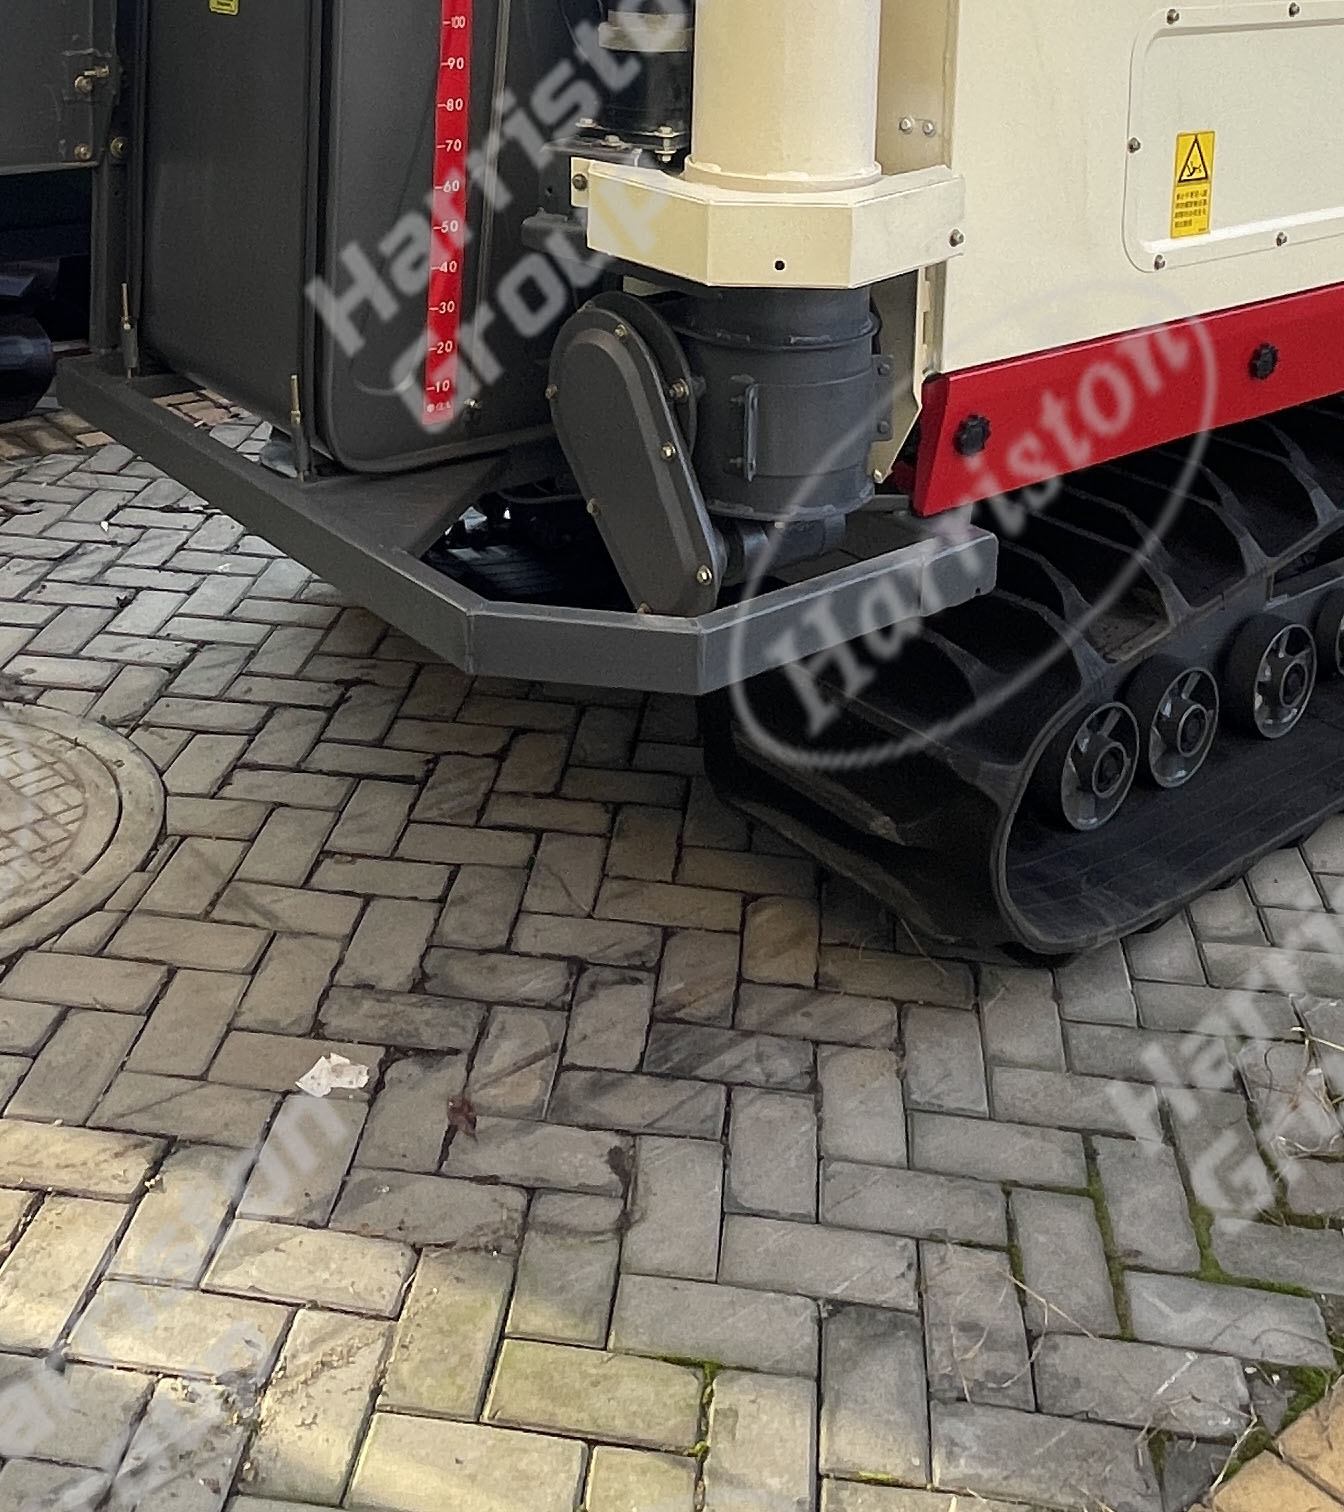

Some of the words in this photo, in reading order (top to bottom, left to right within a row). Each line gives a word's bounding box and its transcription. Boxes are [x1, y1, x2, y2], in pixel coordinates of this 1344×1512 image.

[447, 57, 464, 70] 90
[445, 98, 464, 112] 80
[444, 139, 463, 152] 70
[442, 180, 460, 193] 60
[440, 220, 459, 233] 50
[439, 260, 458, 273] 40
[438, 301, 455, 314] 30
[436, 341, 453, 354] 20
[435, 380, 451, 393] 10
